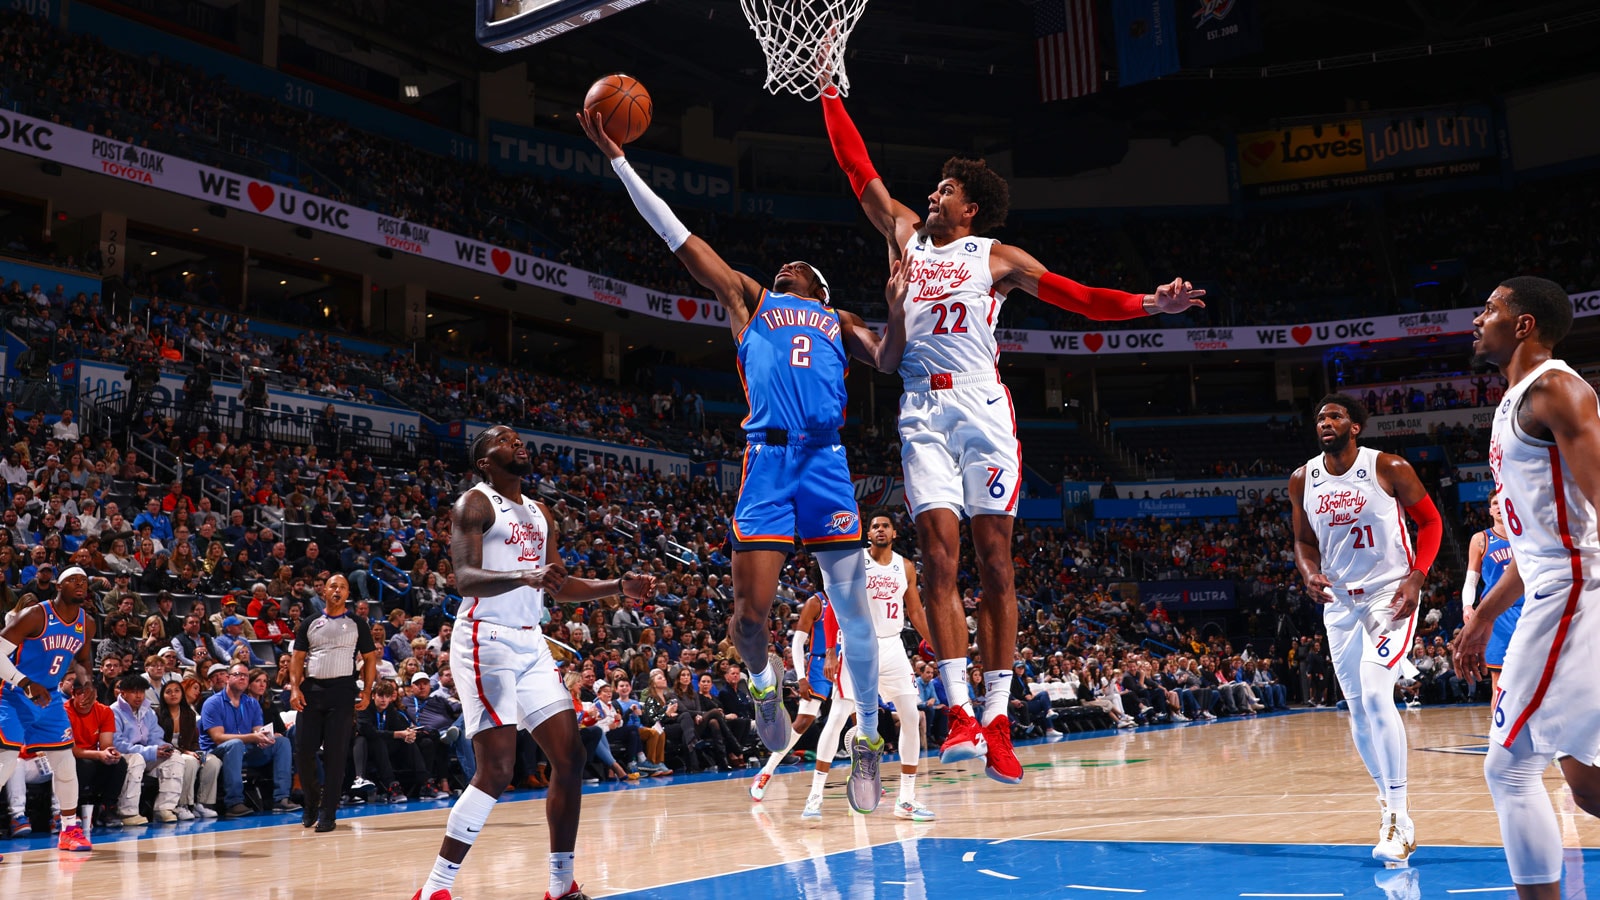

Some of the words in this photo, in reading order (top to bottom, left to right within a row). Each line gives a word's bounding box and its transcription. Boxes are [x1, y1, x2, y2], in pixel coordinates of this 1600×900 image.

[285, 82, 315, 107] 310
[450, 140, 473, 160] 311
[1370, 118, 1429, 163] LOUD
[1436, 116, 1489, 150] CITY
[92, 138, 122, 162] POST
[140, 151, 164, 174] OAK
[492, 134, 677, 191] THUNER
[682, 173, 733, 199] UP
[101, 160, 153, 184] TOYOTA
[1303, 178, 1330, 191] THE
[1331, 171, 1395, 188] THUNDER
[1415, 165, 1445, 178] EXIT
[1449, 161, 1481, 175] NOW
[199, 170, 241, 201] WE
[279, 192, 296, 215] U
[303, 200, 349, 229] OKC
[747, 198, 775, 214] 312
[377, 216, 400, 234] POST
[412, 226, 430, 244] OAK
[107, 229, 117, 268] 209
[384, 235, 422, 254] TOYOTA
[455, 240, 486, 266] WE
[515, 257, 527, 276] U
[532, 262, 568, 288] OKC
[910, 260, 972, 289] Brotherly
[588, 274, 605, 291] POST
[913, 279, 953, 303] Love
[593, 291, 622, 306] TOYOTA
[646, 293, 672, 315] WE
[1572, 295, 1600, 313] KC
[760, 308, 840, 342] THUNDER
[931, 302, 968, 335] 22
[1399, 315, 1419, 328] POST
[1431, 312, 1449, 325] OAK
[1050, 335, 1079, 350] WE
[1108, 334, 1120, 349] U
[1126, 333, 1164, 348] OKC
[1187, 330, 1206, 342] POST
[1217, 329, 1234, 341] OAK
[1257, 329, 1287, 344] WE
[1317, 327, 1329, 340] U
[1335, 321, 1375, 338] OKC
[1407, 326, 1443, 335] TOYOTA
[790, 334, 812, 368] 2
[1194, 341, 1228, 350] TOYOTA
[84, 376, 122, 401] 106
[1377, 422, 1396, 431] POST
[1407, 418, 1422, 428] OAK
[1473, 413, 1492, 423] POST
[526, 440, 661, 475] ASKETBALL
[986, 467, 1006, 498] 76
[1315, 490, 1367, 514] Brotherly
[832, 515, 851, 529] OKC
[1329, 509, 1358, 527] Love
[1505, 497, 1523, 537] 8
[504, 522, 545, 550] Brotherly
[1350, 525, 1375, 549] 21
[517, 541, 541, 562] Love
[1489, 547, 1513, 564] THUN
[866, 575, 900, 593] Brotherly
[872, 587, 892, 600] Love
[1190, 591, 1228, 602] ULTRA
[886, 602, 899, 619] 12
[1375, 635, 1391, 658] 76
[49, 655, 64, 675] 5
